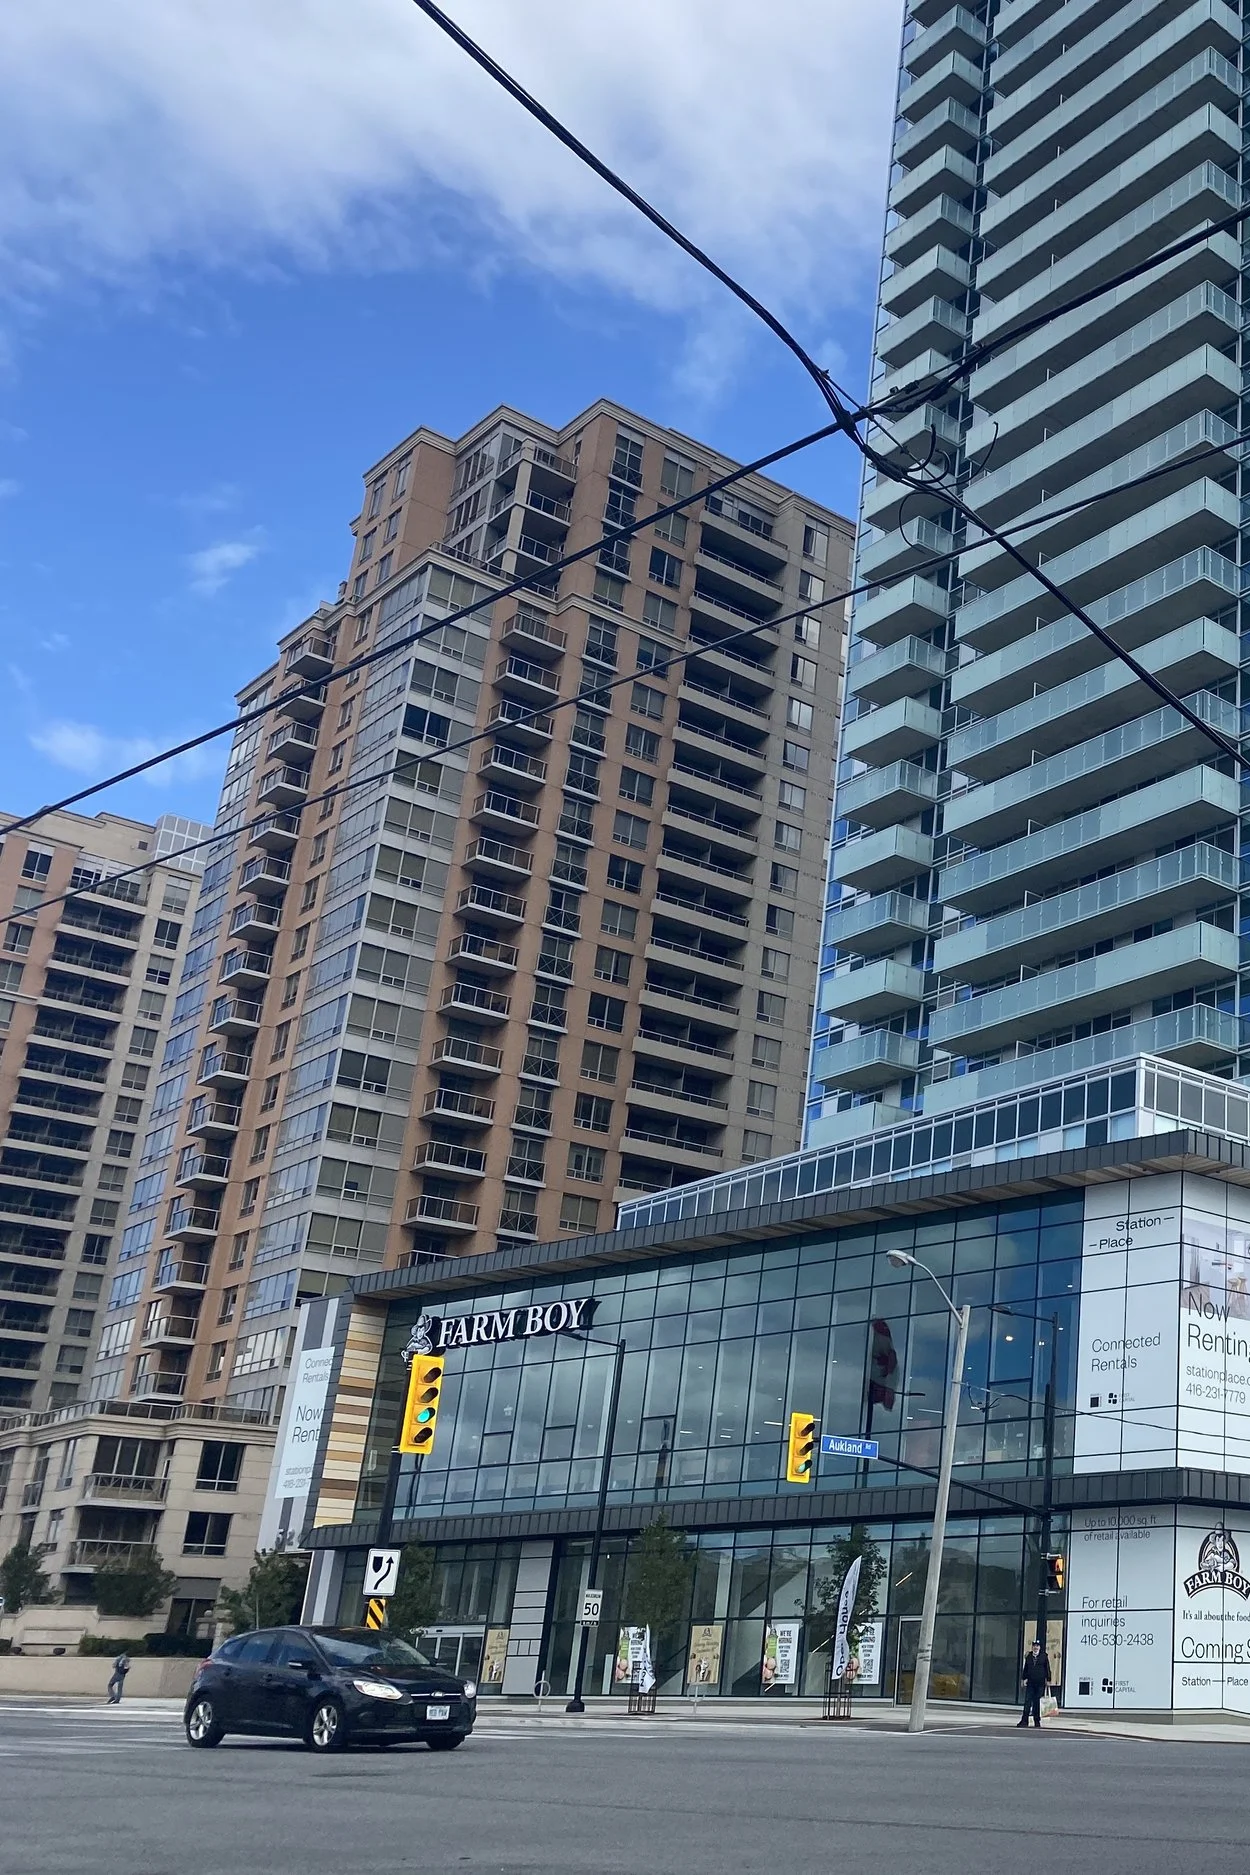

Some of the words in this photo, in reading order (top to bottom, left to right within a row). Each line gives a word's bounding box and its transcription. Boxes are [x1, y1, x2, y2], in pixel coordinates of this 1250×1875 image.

[1116, 1216, 1161, 1232] Station
[1099, 1235, 1133, 1250] Place
[1188, 1292, 1230, 1323] Now
[436, 1309, 518, 1348] FARM
[523, 1298, 588, 1335] BOY
[1092, 1332, 1161, 1353] Connected
[1091, 1355, 1137, 1372] Rentals
[1186, 1383, 1246, 1404] 416-231-7779
[296, 1405, 323, 1422] Now
[829, 1439, 863, 1454] Aukland
[1084, 1518, 1097, 1530] Up
[1098, 1518, 1106, 1527] to
[1084, 1531, 1093, 1541] of
[1094, 1530, 1113, 1540] retail
[1186, 1571, 1222, 1593] FARM
[1224, 1571, 1250, 1594] BOY
[584, 1603, 599, 1615] 50
[1082, 1596, 1099, 1608] For
[1101, 1595, 1128, 1608] retail
[1182, 1609, 1192, 1619] It's
[1194, 1610, 1202, 1620] all
[1204, 1611, 1224, 1620] about
[1225, 1611, 1235, 1621] the
[1081, 1616, 1125, 1632] inquiries
[1080, 1633, 1154, 1647] 416-530-2438
[1181, 1636, 1243, 1663] Coming
[1182, 1677, 1211, 1686] Station
[1227, 1676, 1248, 1686] Place
